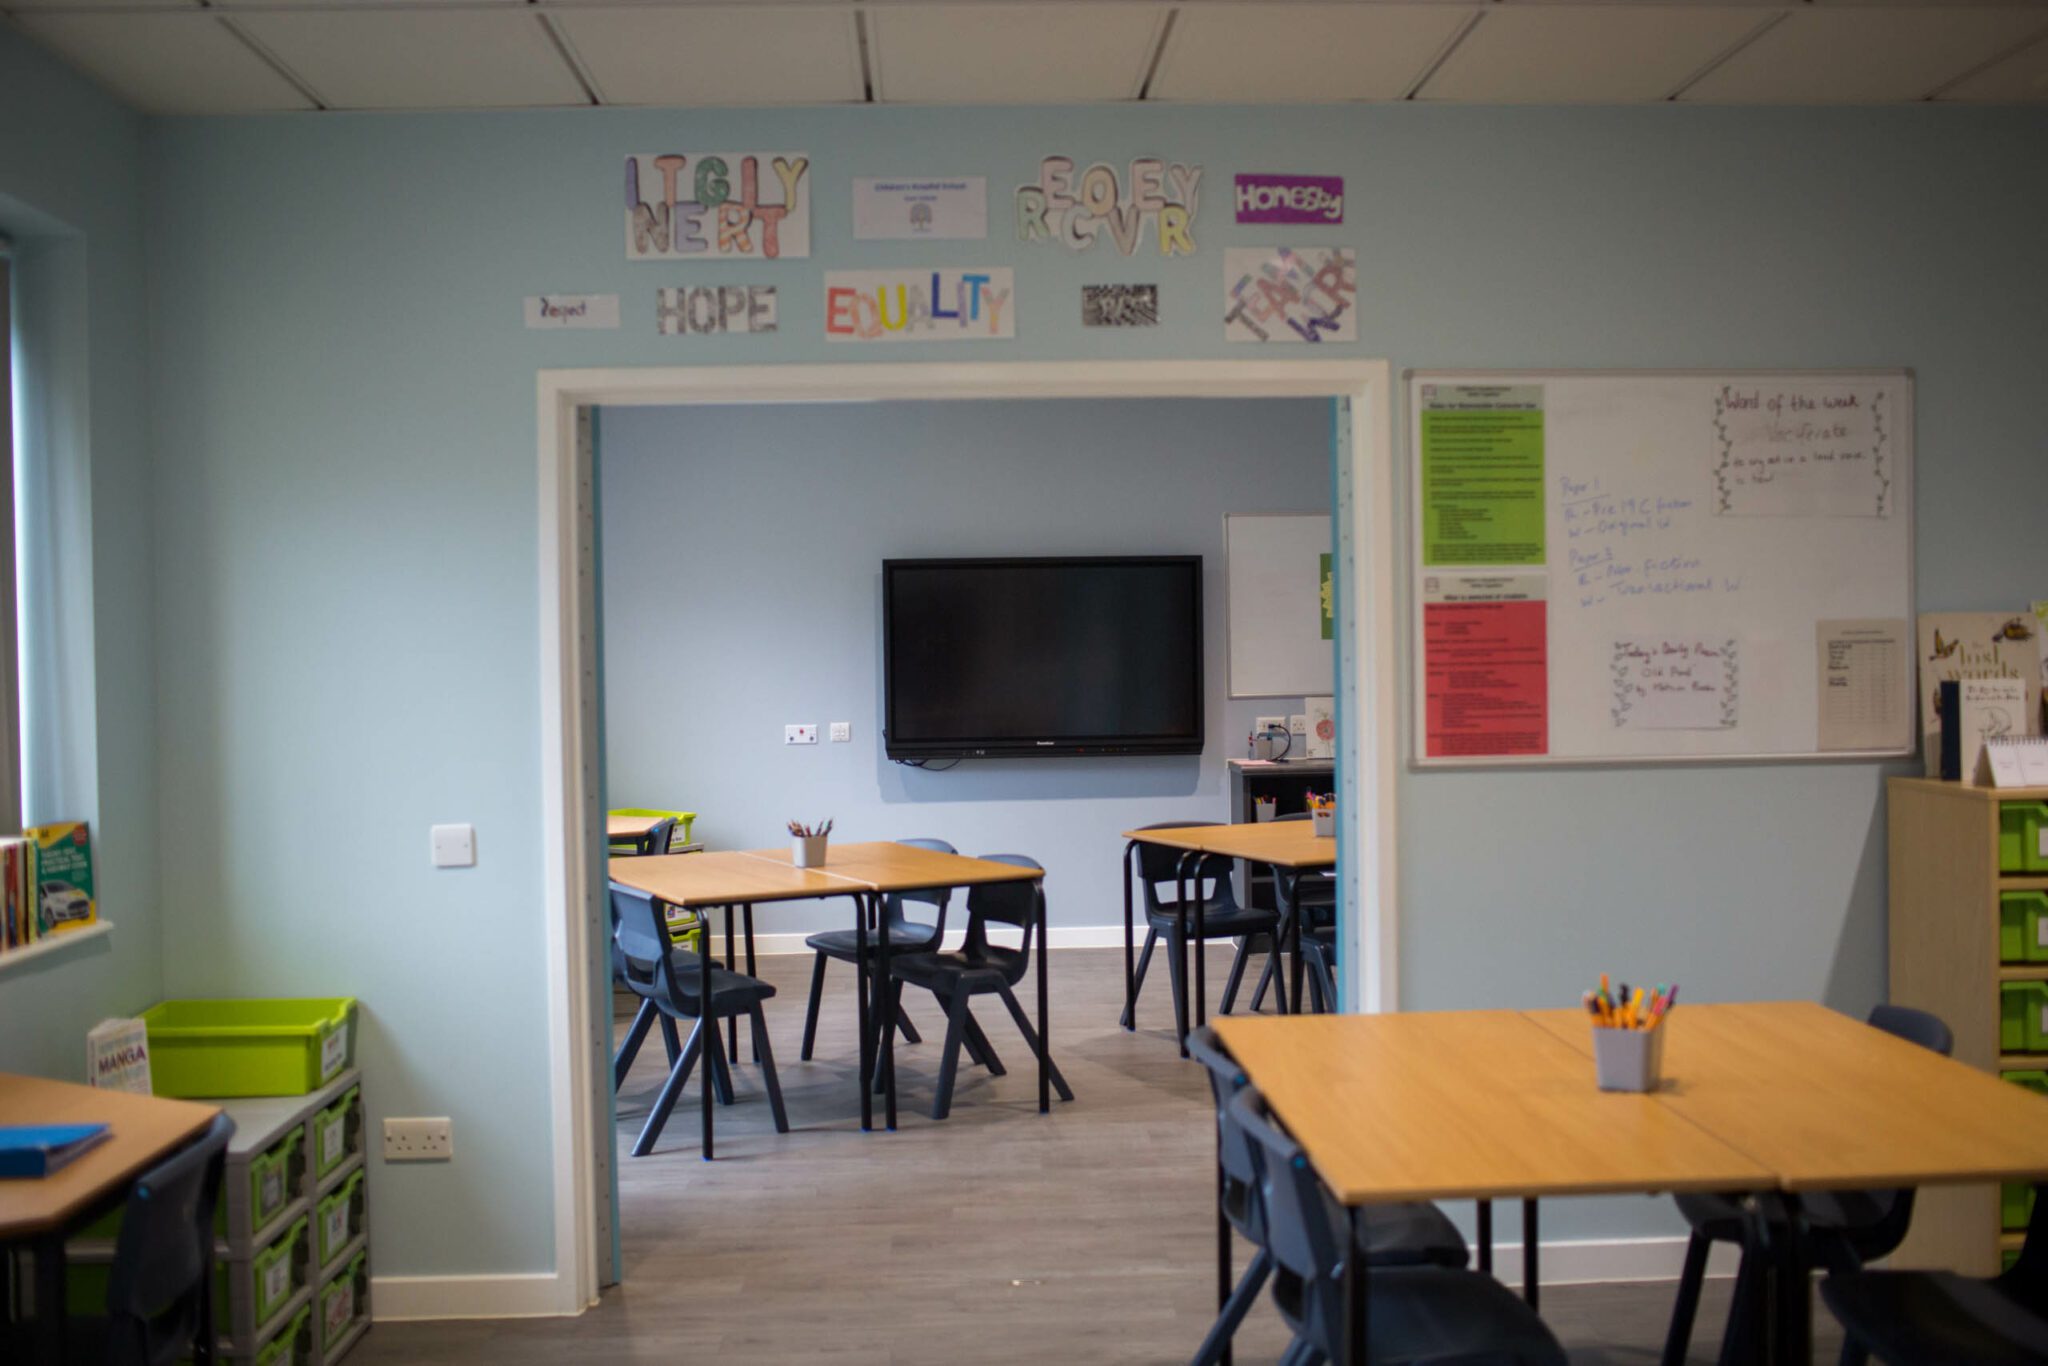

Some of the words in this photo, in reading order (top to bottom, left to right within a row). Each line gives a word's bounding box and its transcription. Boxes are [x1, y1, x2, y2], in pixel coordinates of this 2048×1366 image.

[657, 286, 777, 335] HOPE
[827, 272, 1010, 340] EQUALITY
[1724, 391, 1759, 409] Word
[1767, 394, 1784, 417] of
[1791, 393, 1816, 412] the
[98, 1044, 147, 1075] MANGA
